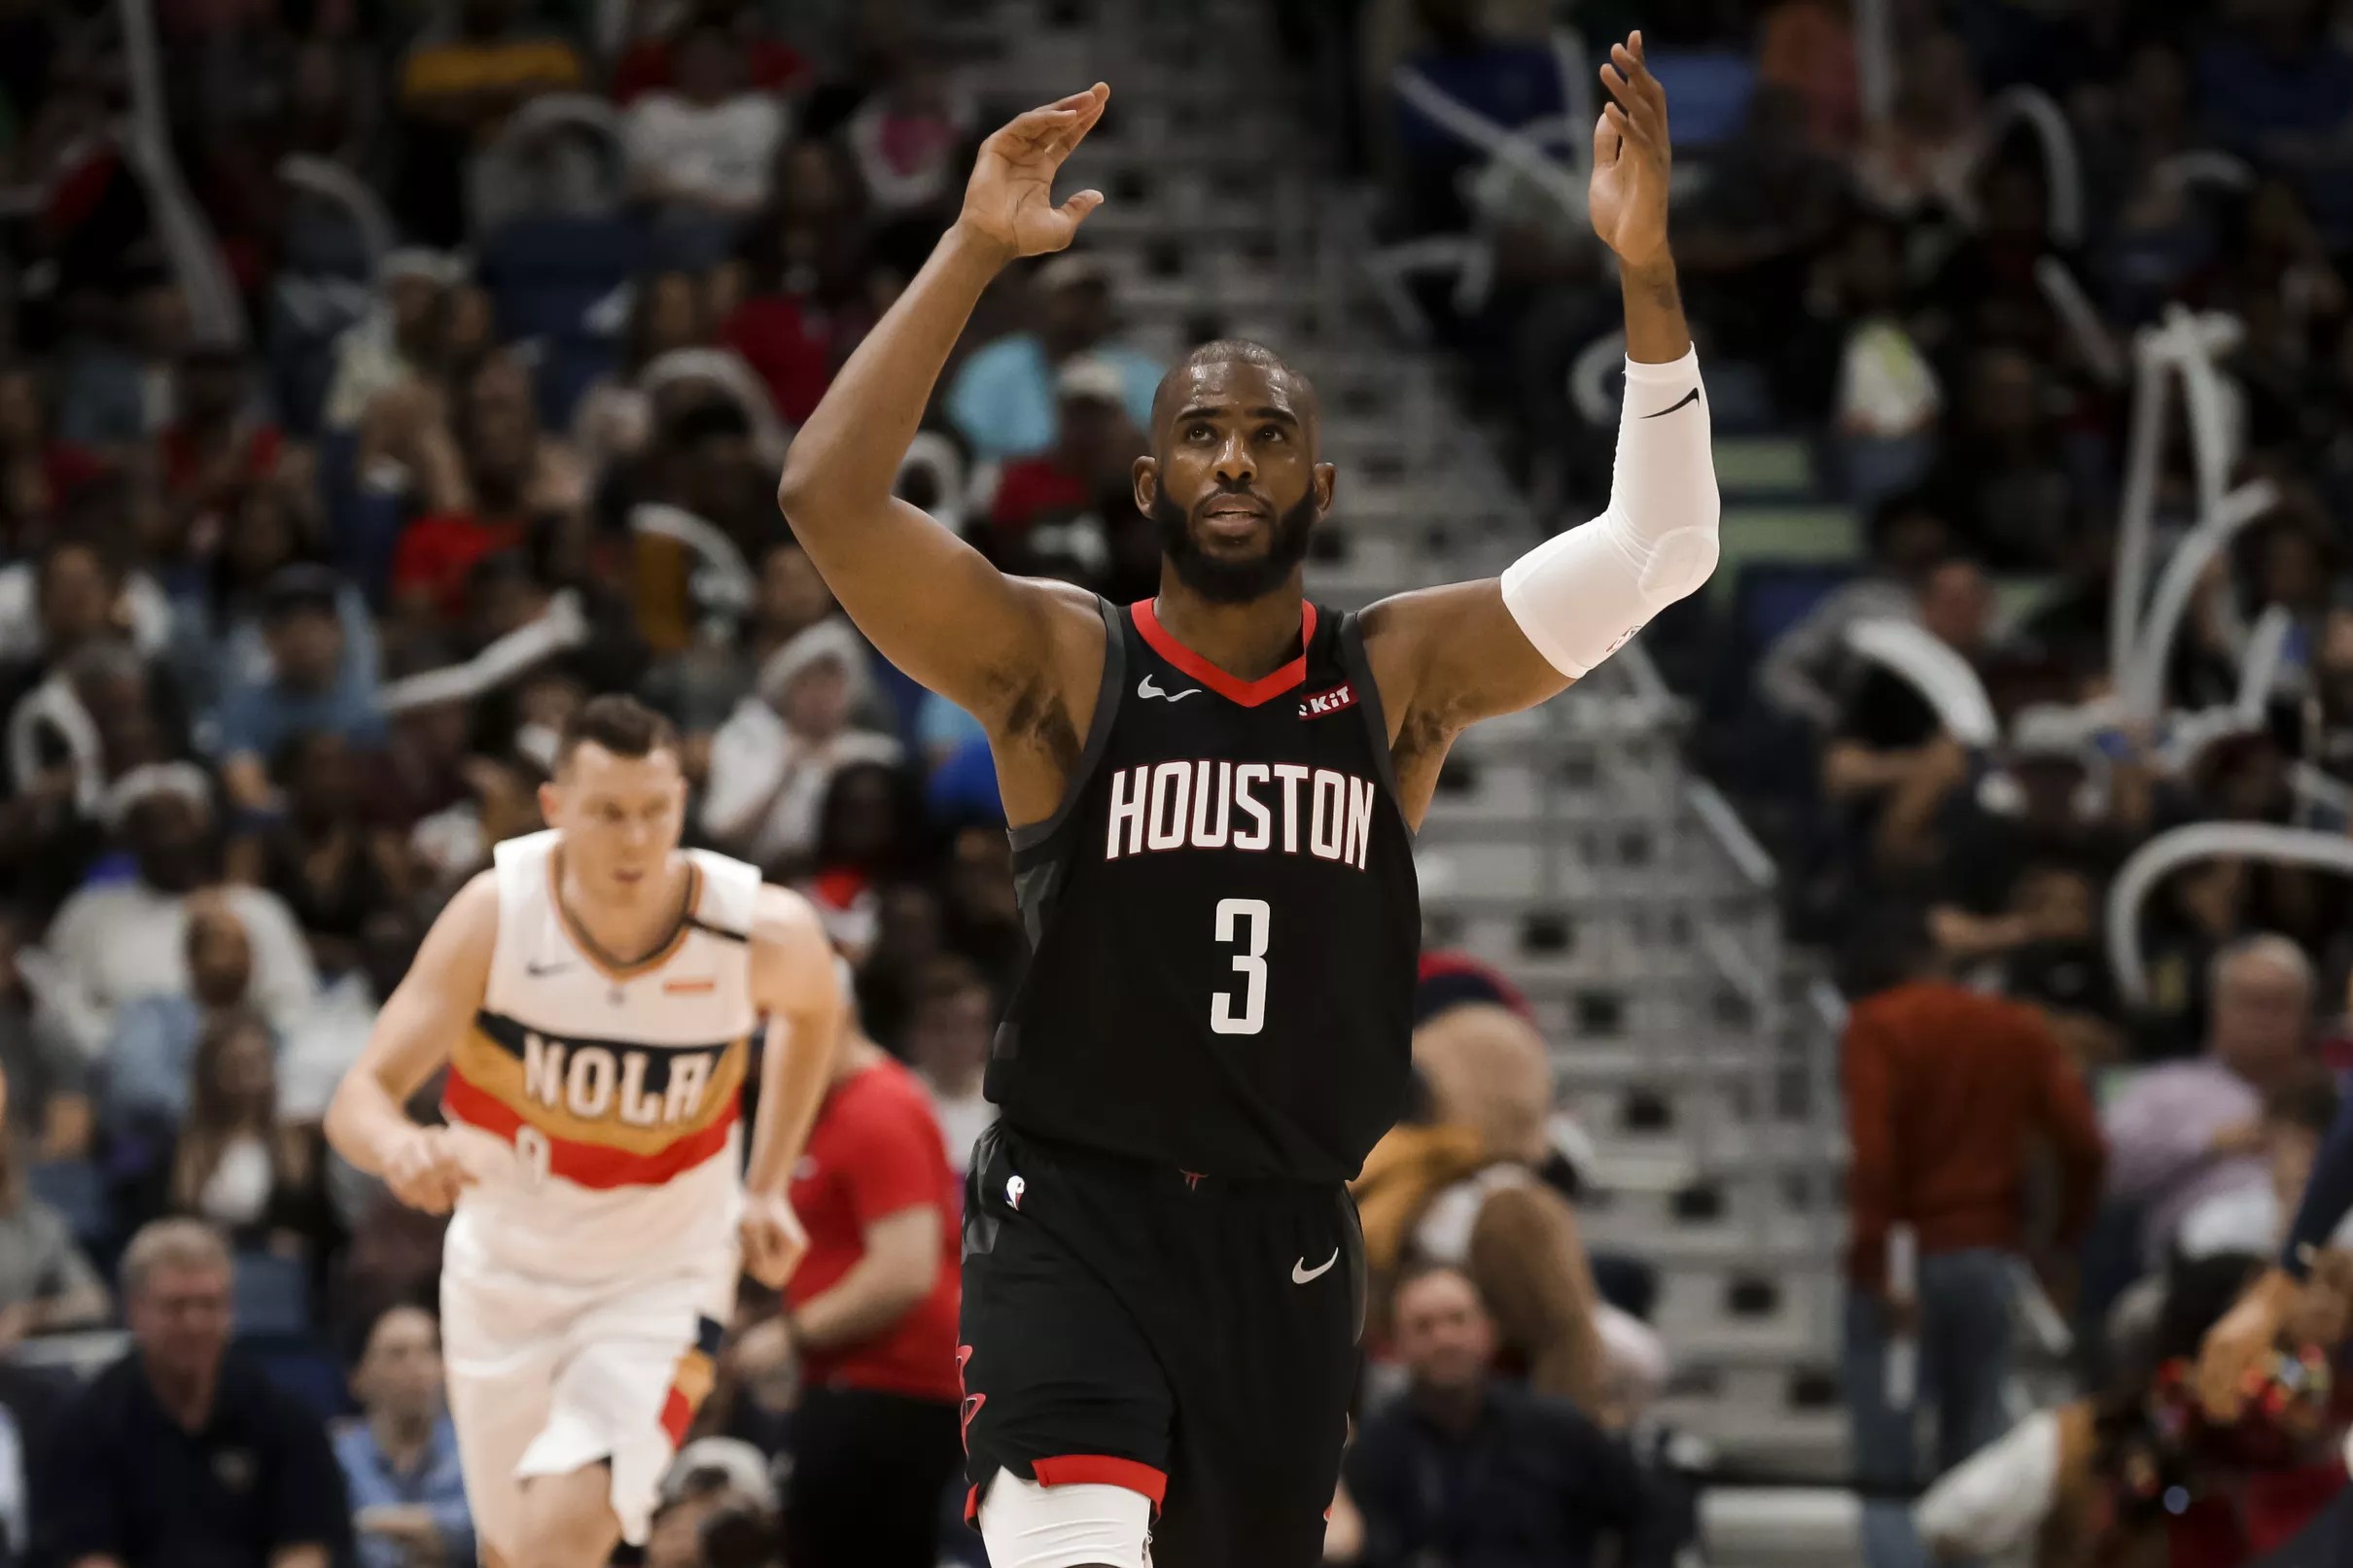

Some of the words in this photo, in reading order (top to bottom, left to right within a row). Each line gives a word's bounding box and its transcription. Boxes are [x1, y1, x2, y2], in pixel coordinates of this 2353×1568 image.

[1106, 760, 1376, 871] HOUSTON
[1211, 898, 1271, 1035] 3
[522, 1031, 713, 1126] NOLA
